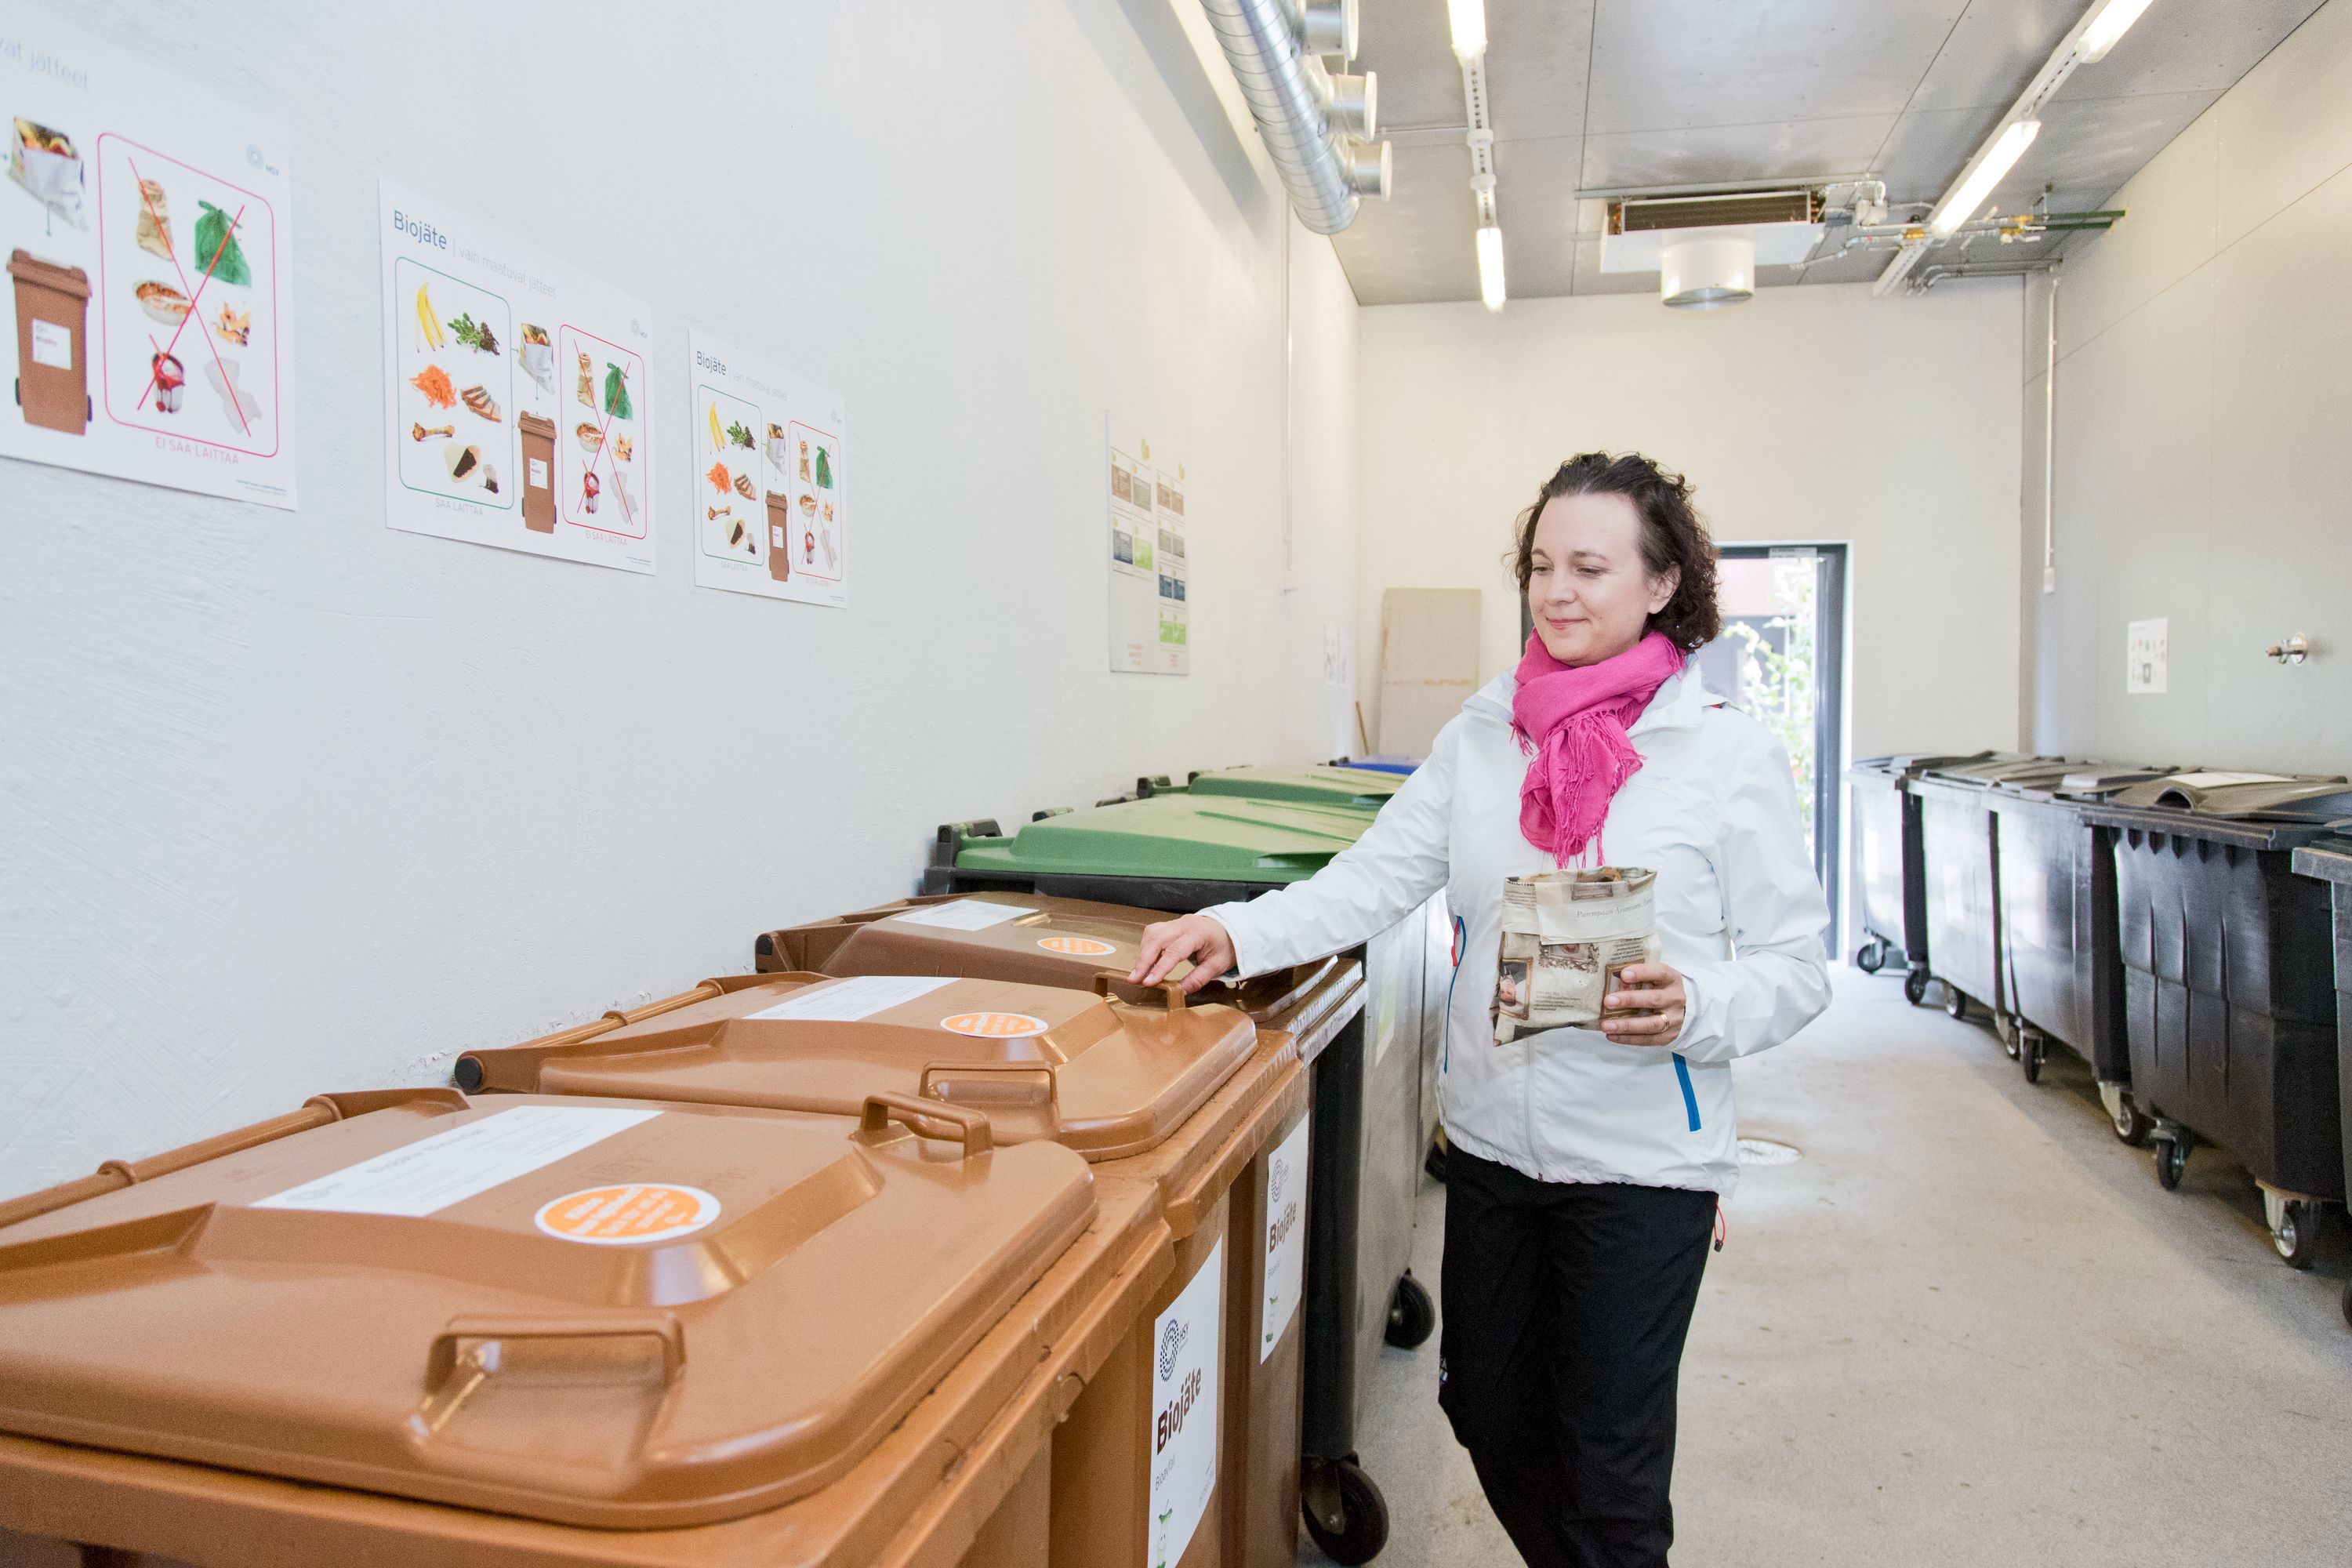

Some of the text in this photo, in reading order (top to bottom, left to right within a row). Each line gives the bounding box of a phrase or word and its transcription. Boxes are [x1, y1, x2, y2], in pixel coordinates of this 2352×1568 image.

[265, 165, 280, 176] HSY
[394, 209, 557, 299] Biojäte vain maatuvat jätteet
[697, 350, 726, 376] Biojäte
[155, 435, 239, 465] EI SAA LAITTAA
[434, 498, 484, 517] SAA LAITTAA
[1269, 1202, 1297, 1254] Biojäte
[1179, 1319, 1189, 1345] HSY
[1156, 1367, 1201, 1456] Biojäte
